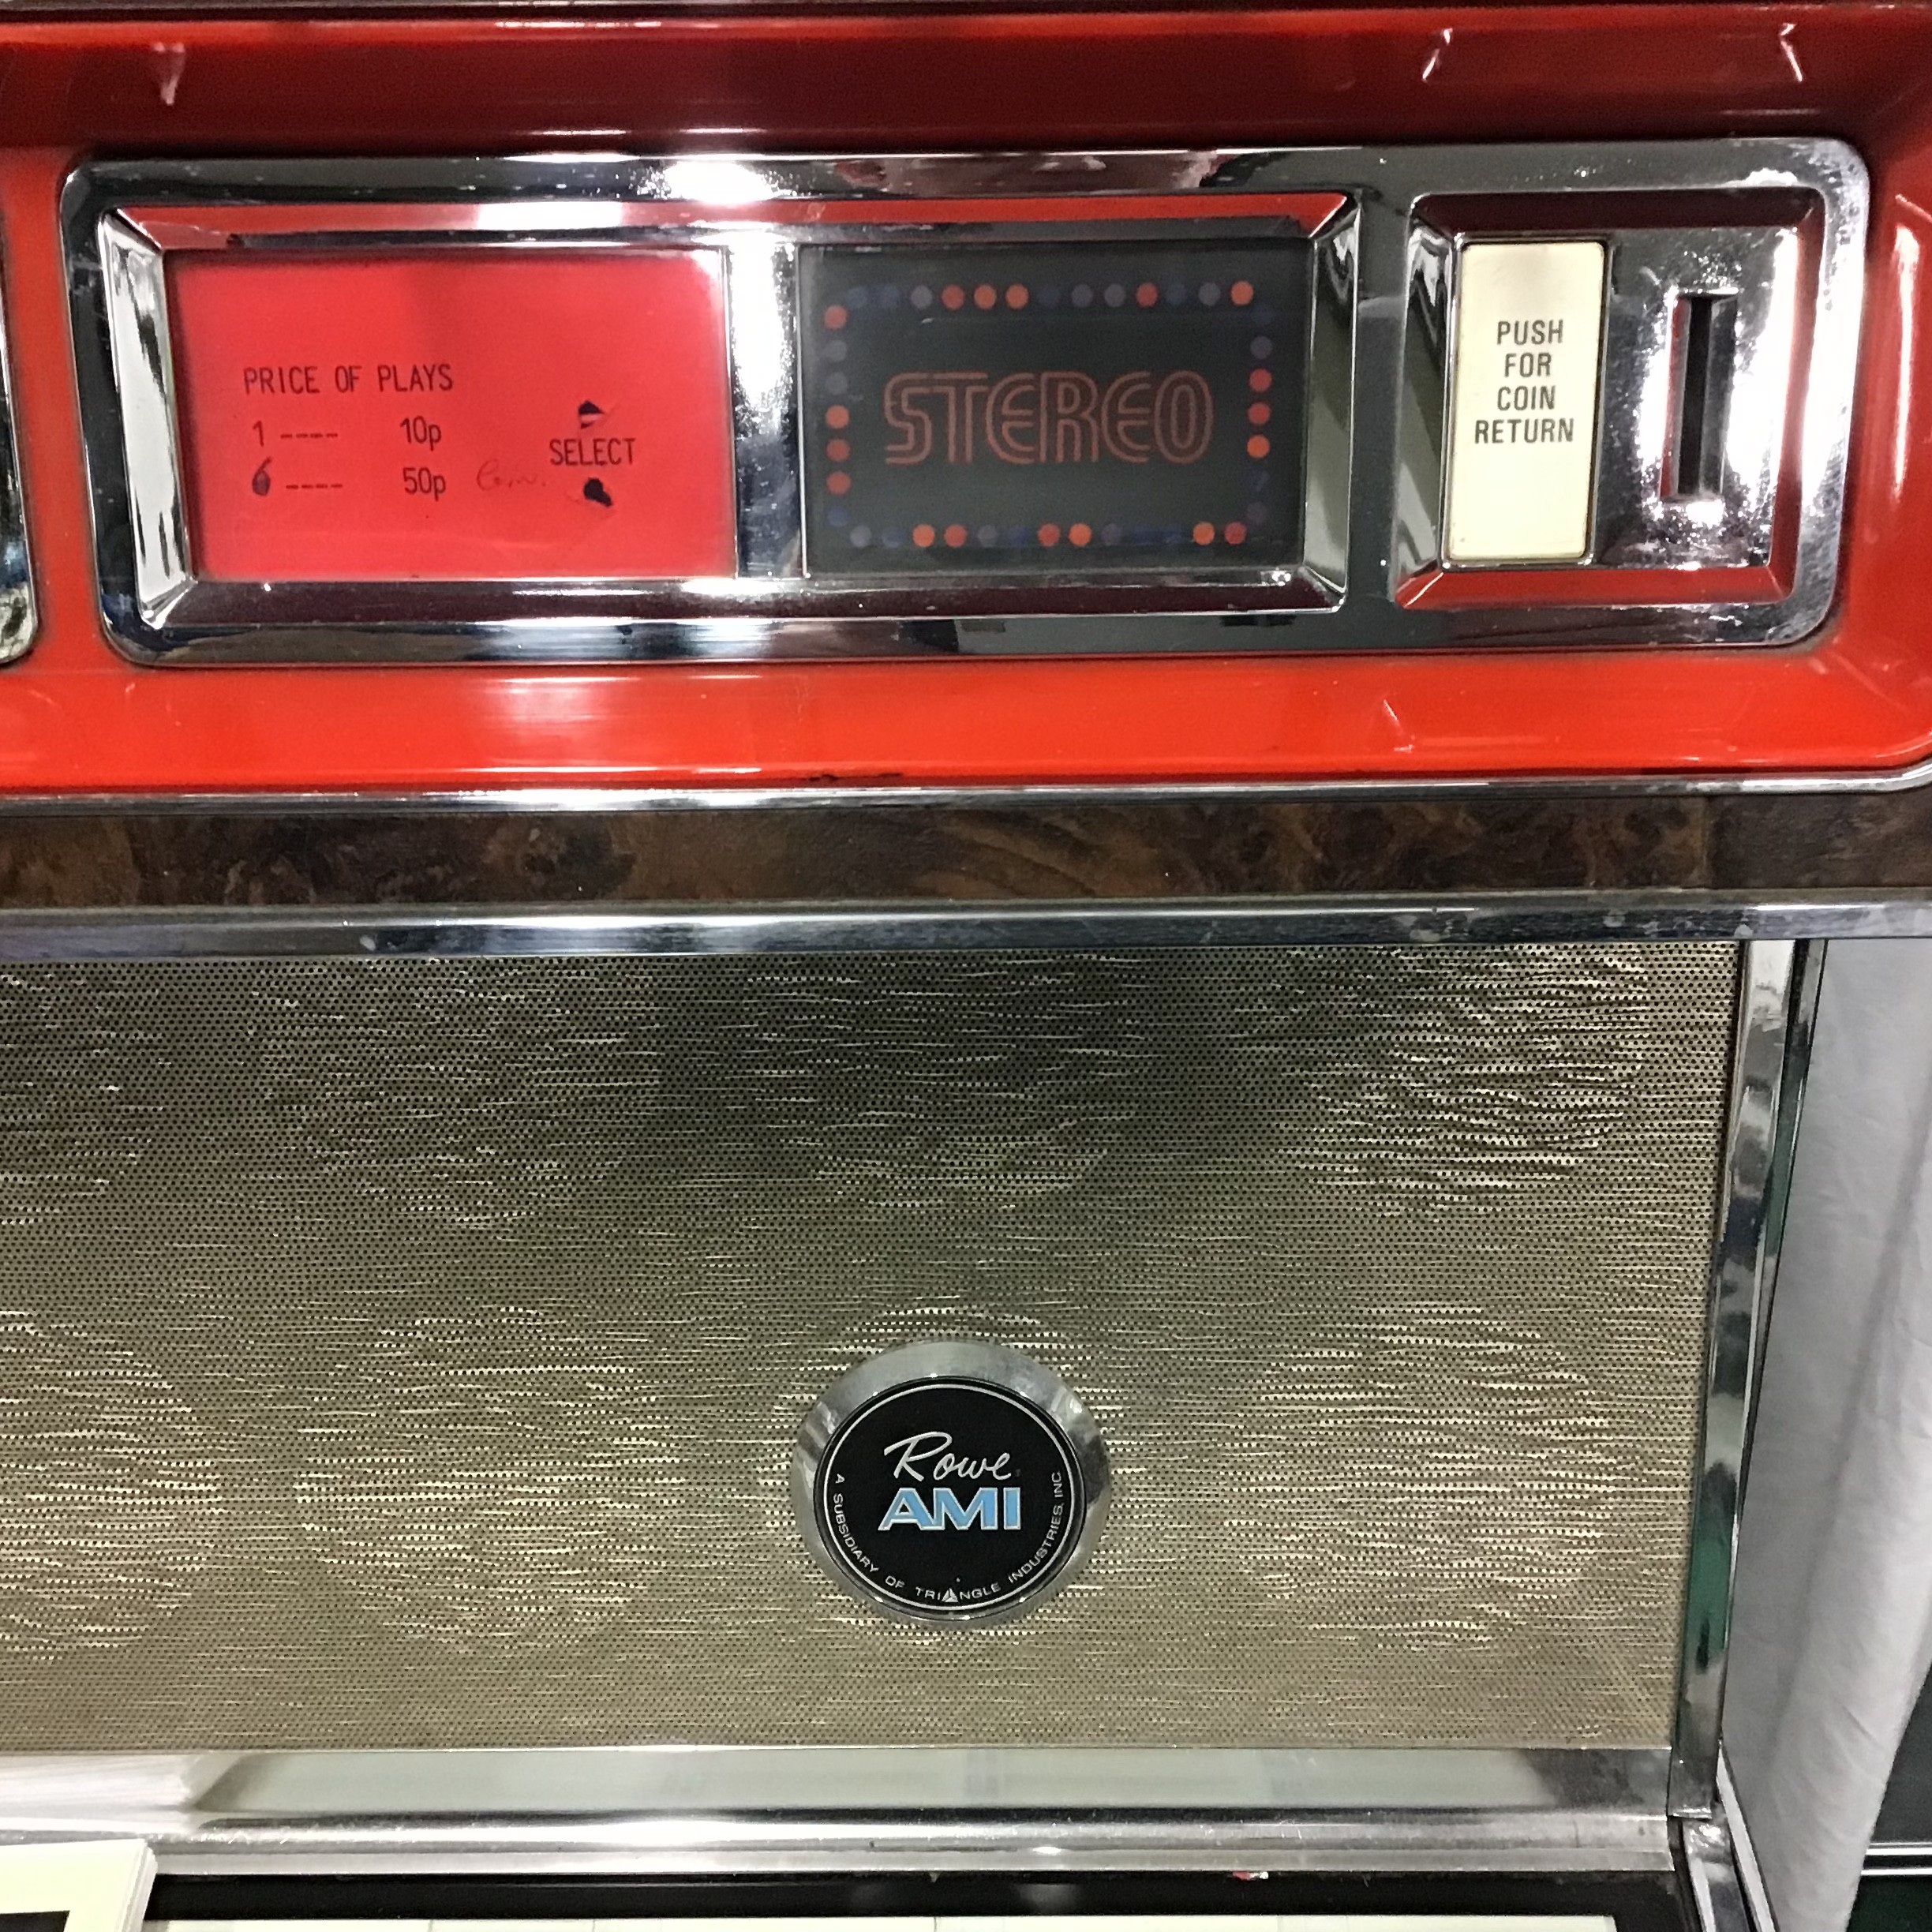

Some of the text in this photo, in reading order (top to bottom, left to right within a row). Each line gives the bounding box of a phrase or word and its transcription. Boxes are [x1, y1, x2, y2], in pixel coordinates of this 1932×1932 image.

[1497, 319, 1564, 345] PUSH
[243, 363, 454, 395] PRICE OF PLAYS
[1504, 352, 1552, 378] FOR
[1496, 385, 1556, 411] COIN
[882, 370, 1215, 464] STEREO
[1474, 417, 1574, 444] RETURN
[252, 415, 442, 451] 1 10p
[549, 438, 636, 466] SELECT
[402, 467, 447, 501] 50p
[883, 1430, 1012, 1482] Rowe
[834, 1473, 845, 1484] A
[877, 1487, 1022, 1531] AMI
[833, 1492, 880, 1573] SUBSIDIARY
[885, 1575, 906, 1589] OF
[915, 1582, 1002, 1603] TRIANGLE
